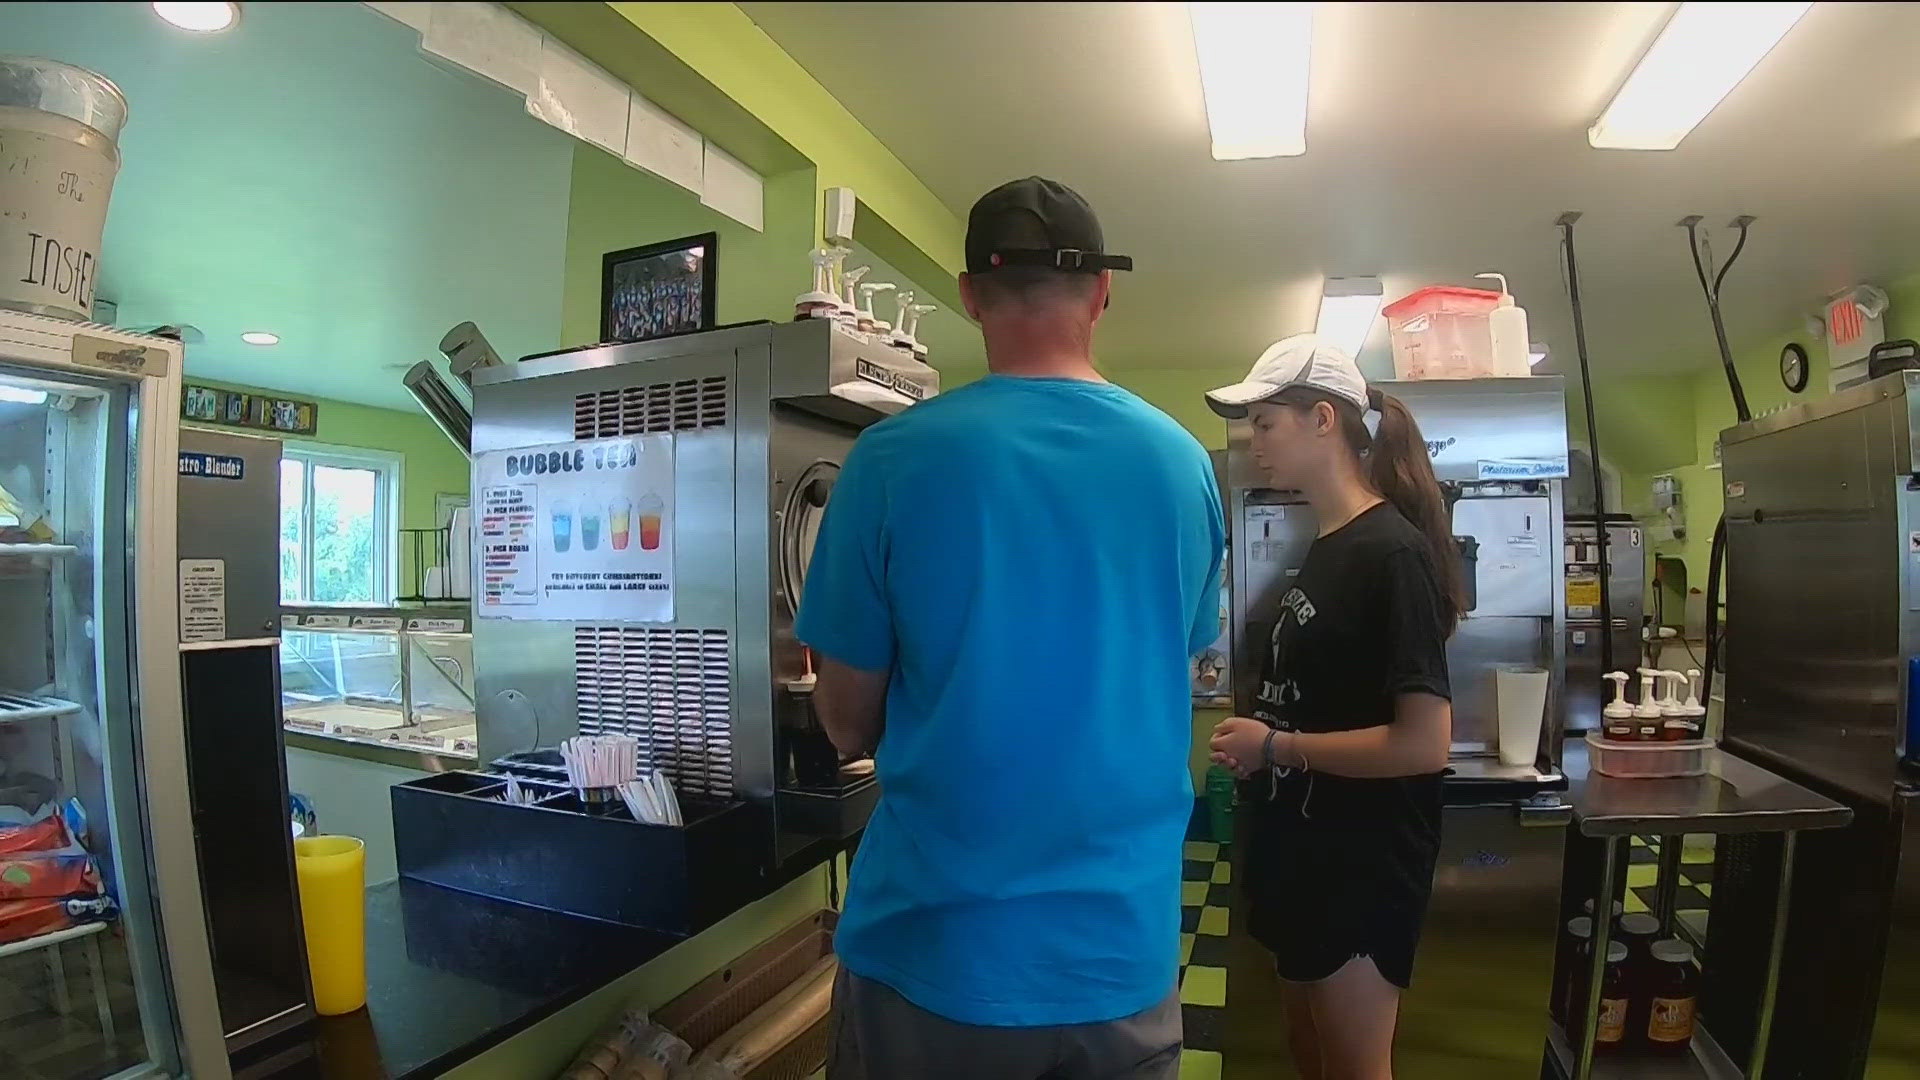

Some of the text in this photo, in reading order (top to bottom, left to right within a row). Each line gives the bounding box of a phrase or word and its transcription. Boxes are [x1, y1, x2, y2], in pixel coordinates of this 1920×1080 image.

[58, 171, 84, 202] The
[506, 449, 585, 478] BUBBLE
[1632, 529, 1640, 546] 3
